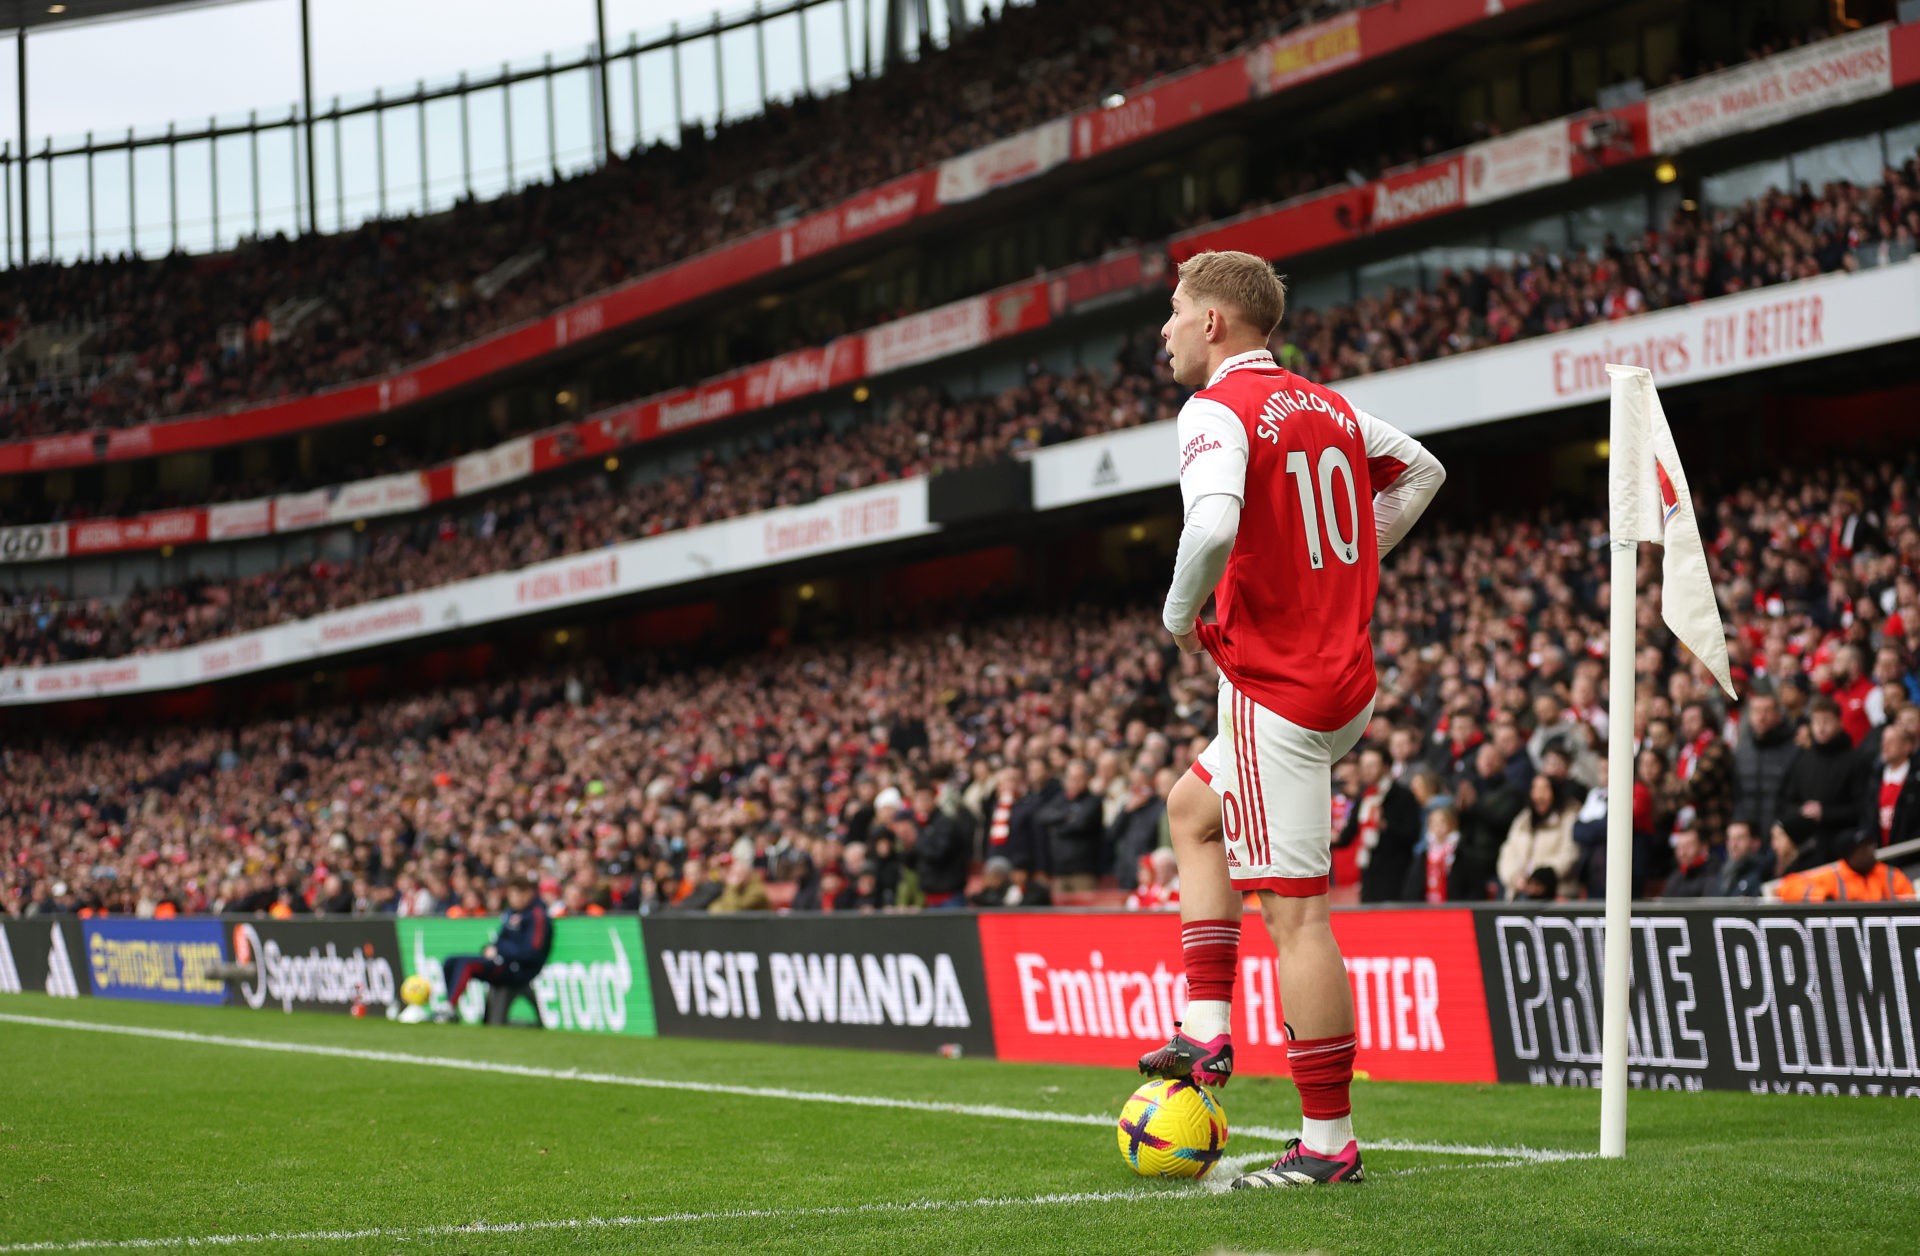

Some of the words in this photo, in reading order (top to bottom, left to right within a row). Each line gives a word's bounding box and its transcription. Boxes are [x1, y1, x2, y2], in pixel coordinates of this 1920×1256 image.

[1787, 46, 1888, 95] GOONERS
[1373, 164, 1460, 224] Arsenal
[1552, 330, 1690, 397] Emirates
[1702, 312, 1739, 369] FLY
[1744, 295, 1824, 357] BETTER
[1182, 433, 1206, 457] VISIT
[1256, 390, 1298, 445] SMITH
[1296, 389, 1356, 440] ROWE
[1180, 440, 1222, 478] RWANDA
[1285, 446, 1359, 570] 10
[661, 950, 761, 1020] VISIT
[769, 951, 972, 1029] RWANDA
[1014, 949, 1190, 1042] Emirate
[1241, 956, 1285, 1047] FL
[1343, 956, 1446, 1052] TTER
